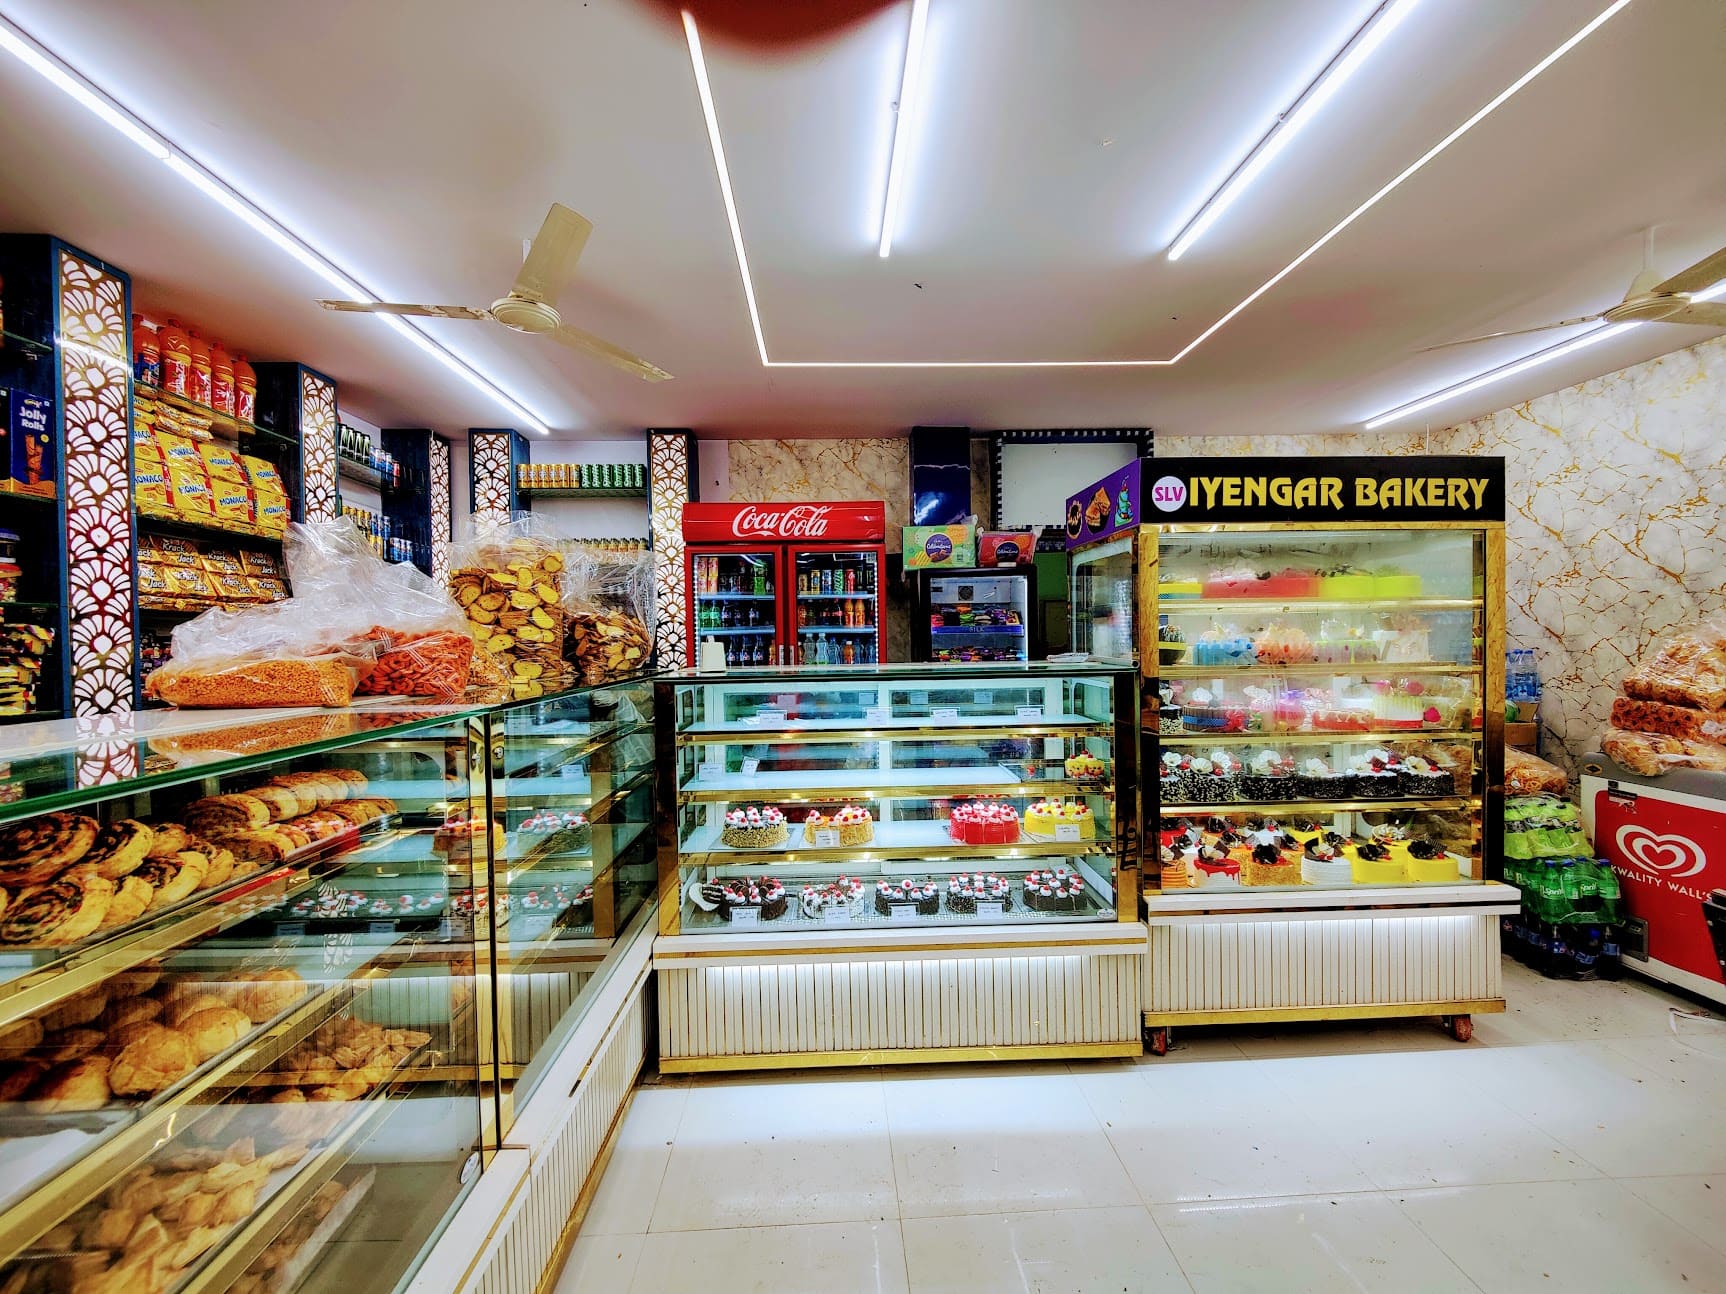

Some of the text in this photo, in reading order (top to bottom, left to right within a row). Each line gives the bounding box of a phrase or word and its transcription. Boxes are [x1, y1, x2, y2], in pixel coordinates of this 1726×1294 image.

[19, 407, 47, 424] Jolly
[21, 418, 45, 431] Rolls
[1154, 477, 1489, 511] SLV IYENGAR BAKERY
[220, 496, 247, 506] MONACO
[264, 506, 286, 515] MONACO
[732, 505, 833, 537] Coca-Cola
[162, 542, 185, 552] Krack
[137, 549, 151, 558] ack
[178, 554, 194, 565] Jack
[149, 579, 166, 588] Jack
[1610, 864, 1662, 887] KWALITY
